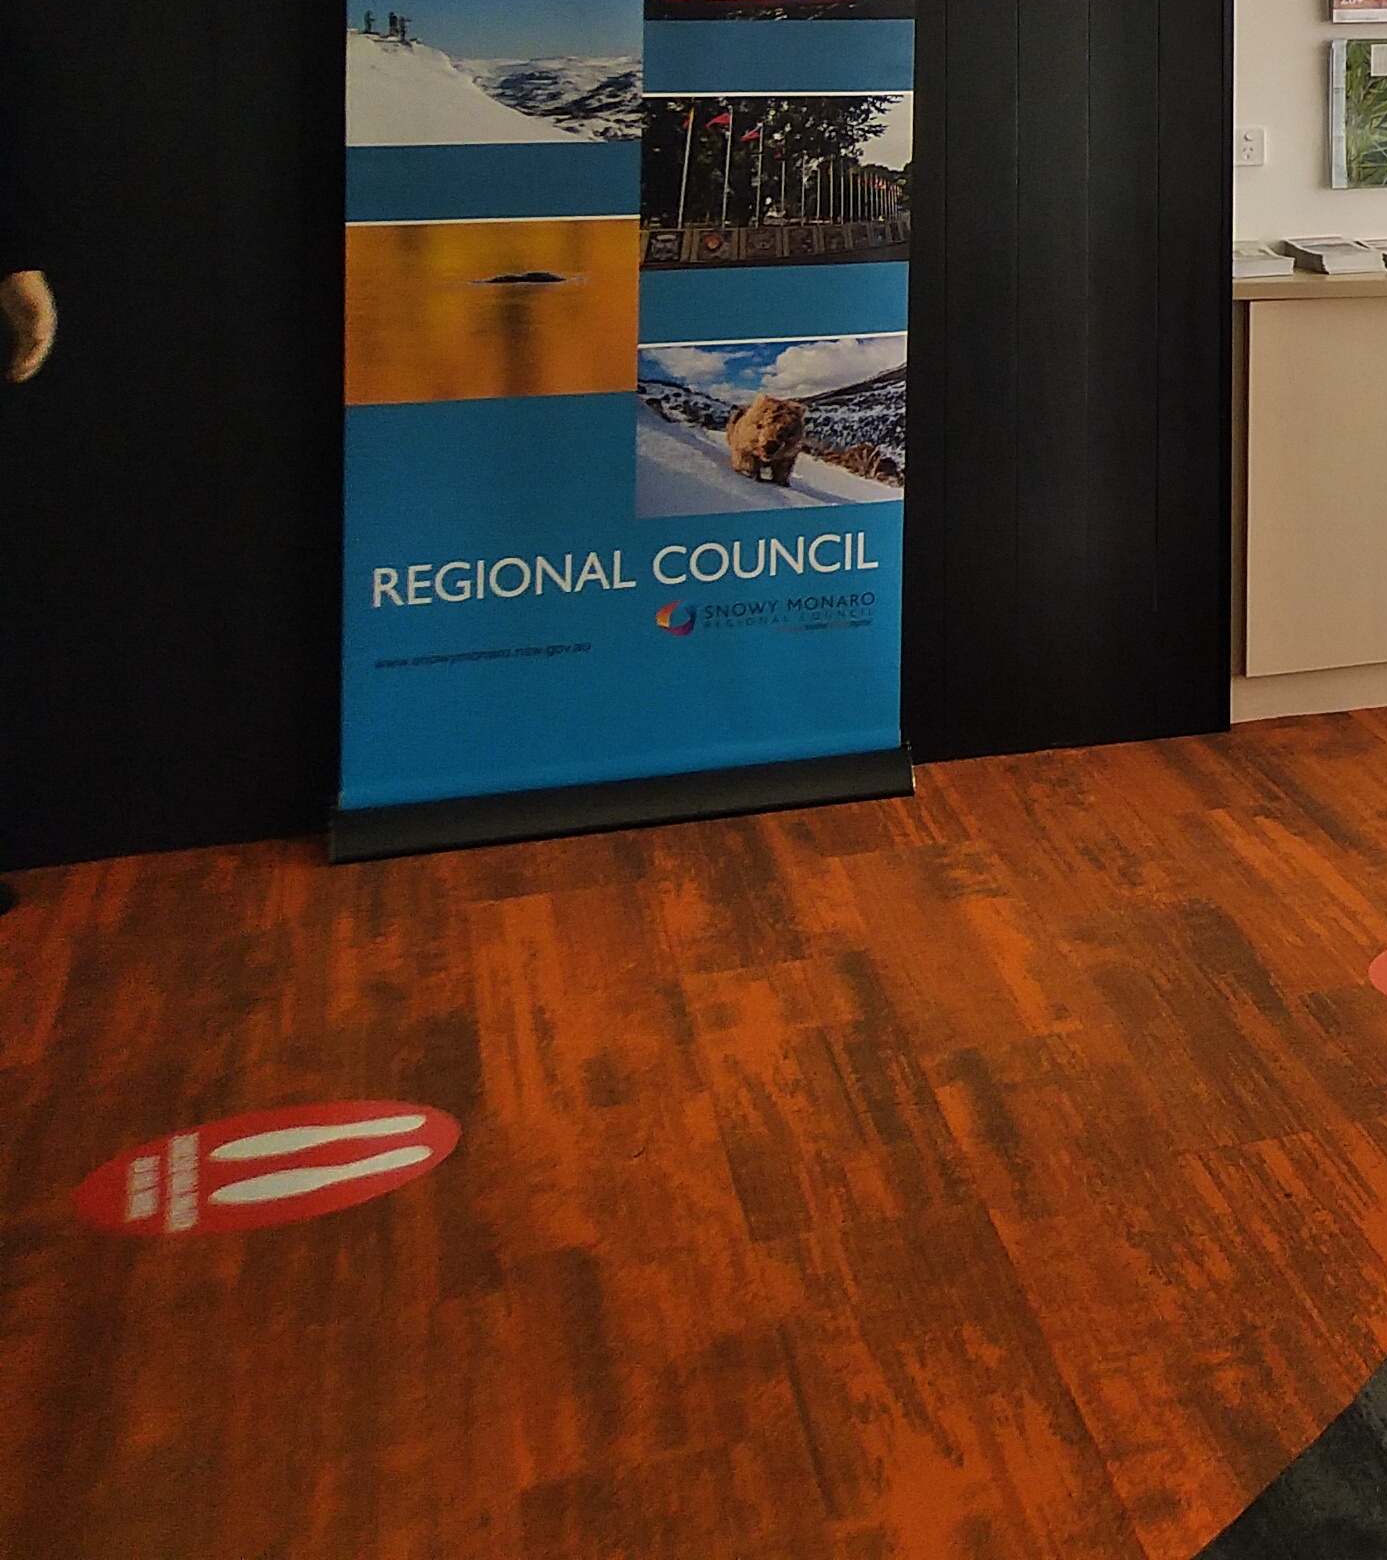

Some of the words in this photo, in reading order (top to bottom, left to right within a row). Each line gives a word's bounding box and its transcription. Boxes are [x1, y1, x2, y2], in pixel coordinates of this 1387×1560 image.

[371, 550, 637, 608] REGIONAL
[652, 532, 879, 586] COUNCIL
[703, 599, 779, 619] SNOWY
[786, 591, 876, 611] MONARO
